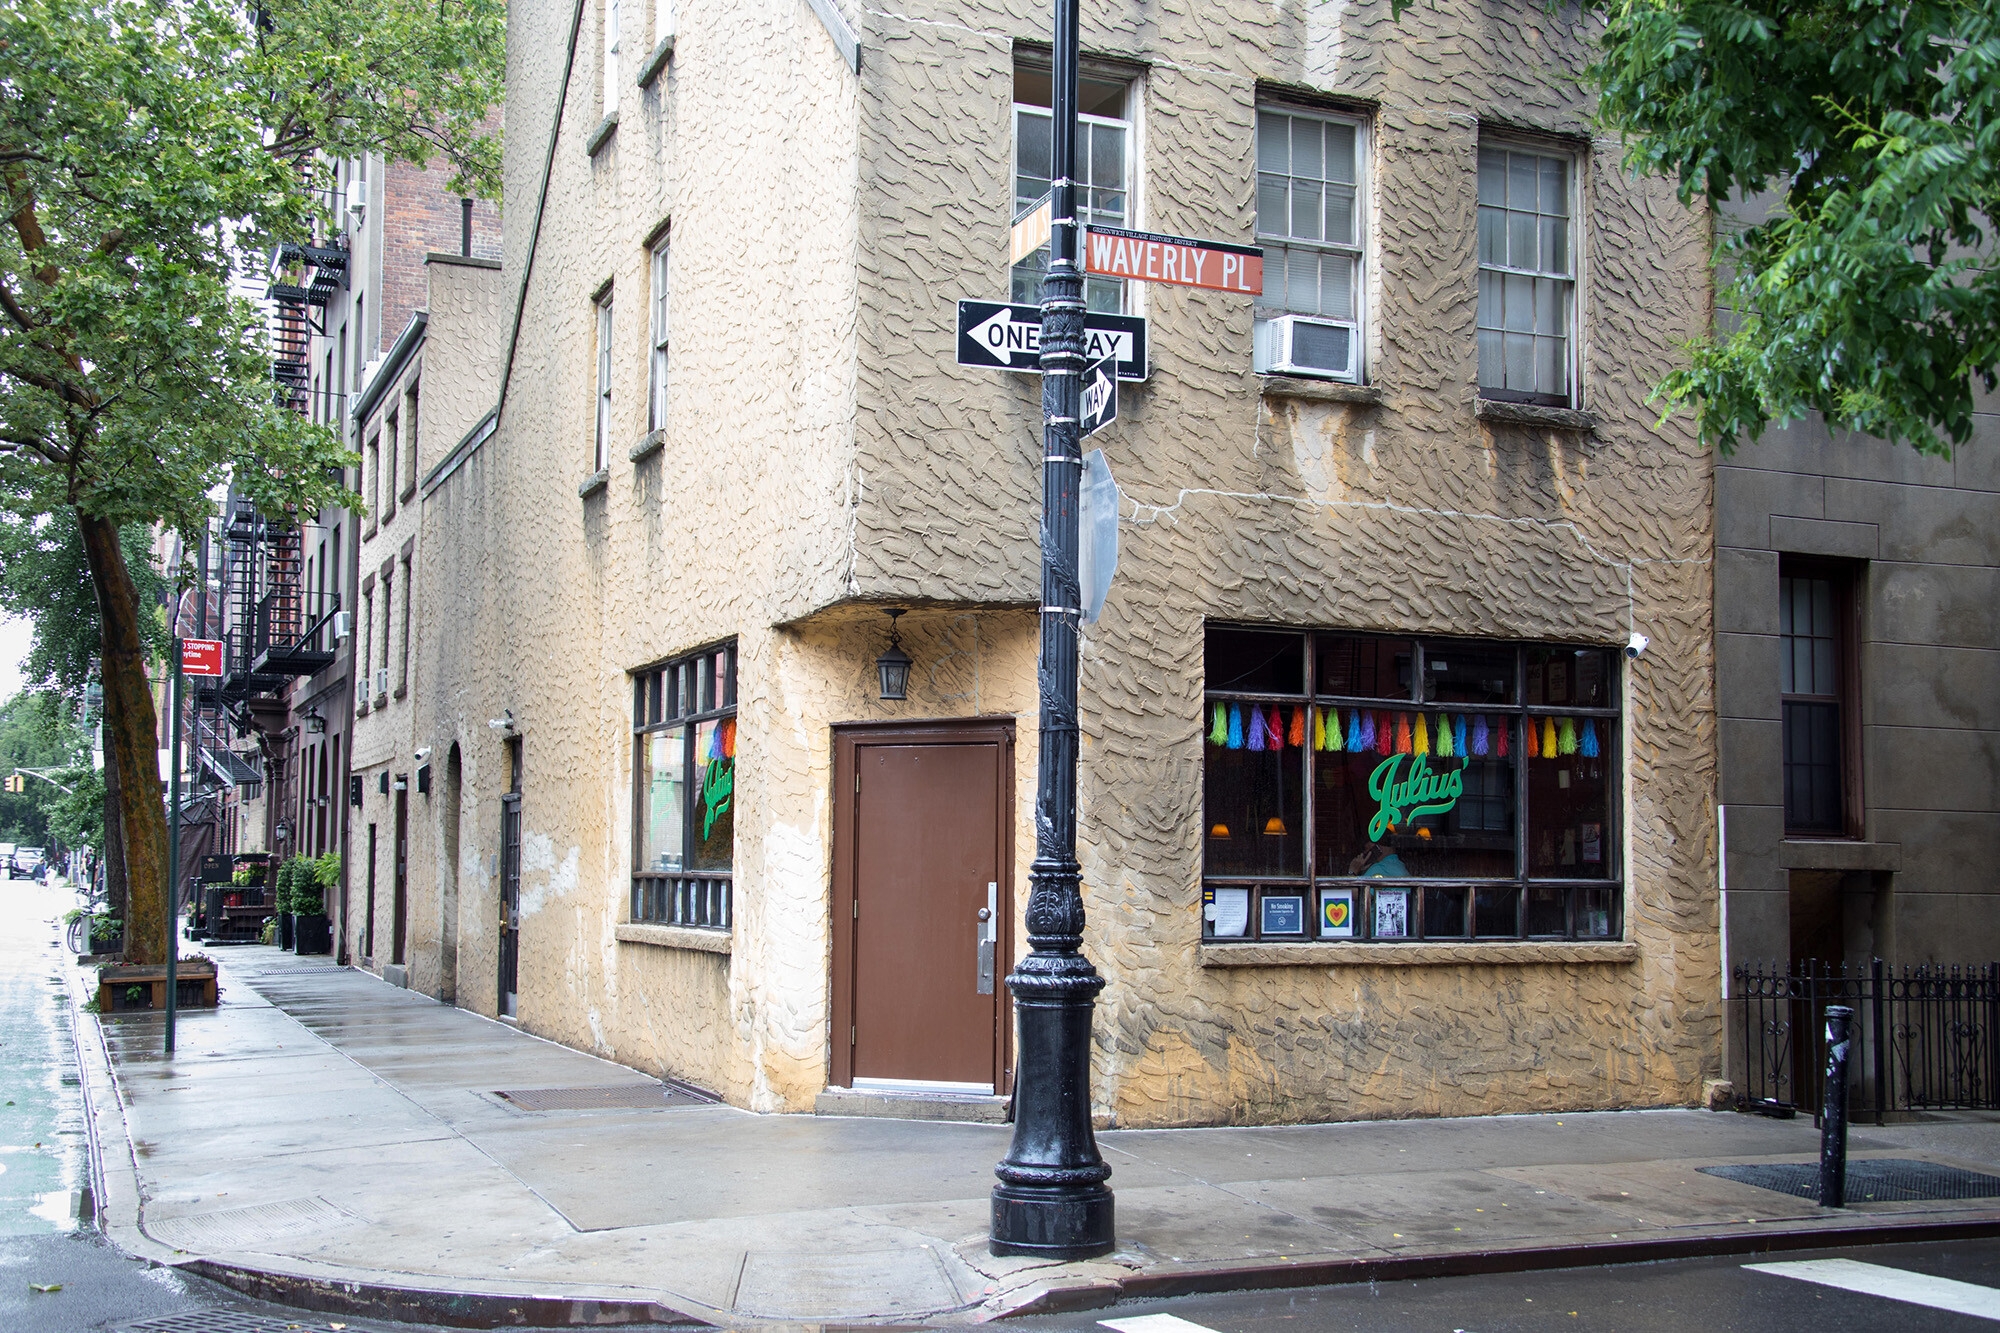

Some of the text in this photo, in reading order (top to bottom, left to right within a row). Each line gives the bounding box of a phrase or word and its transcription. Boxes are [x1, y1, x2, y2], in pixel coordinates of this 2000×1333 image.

[1092, 226, 1198, 247] GREENWICH VILLAGE HISTORIC DISTRICT
[1092, 234, 1251, 291] WAVERLY PL
[988, 323, 1122, 357] ONE AY
[1085, 379, 1106, 416] WAY
[187, 643, 215, 651] STOPPING
[1368, 751, 1470, 843] Julius'
